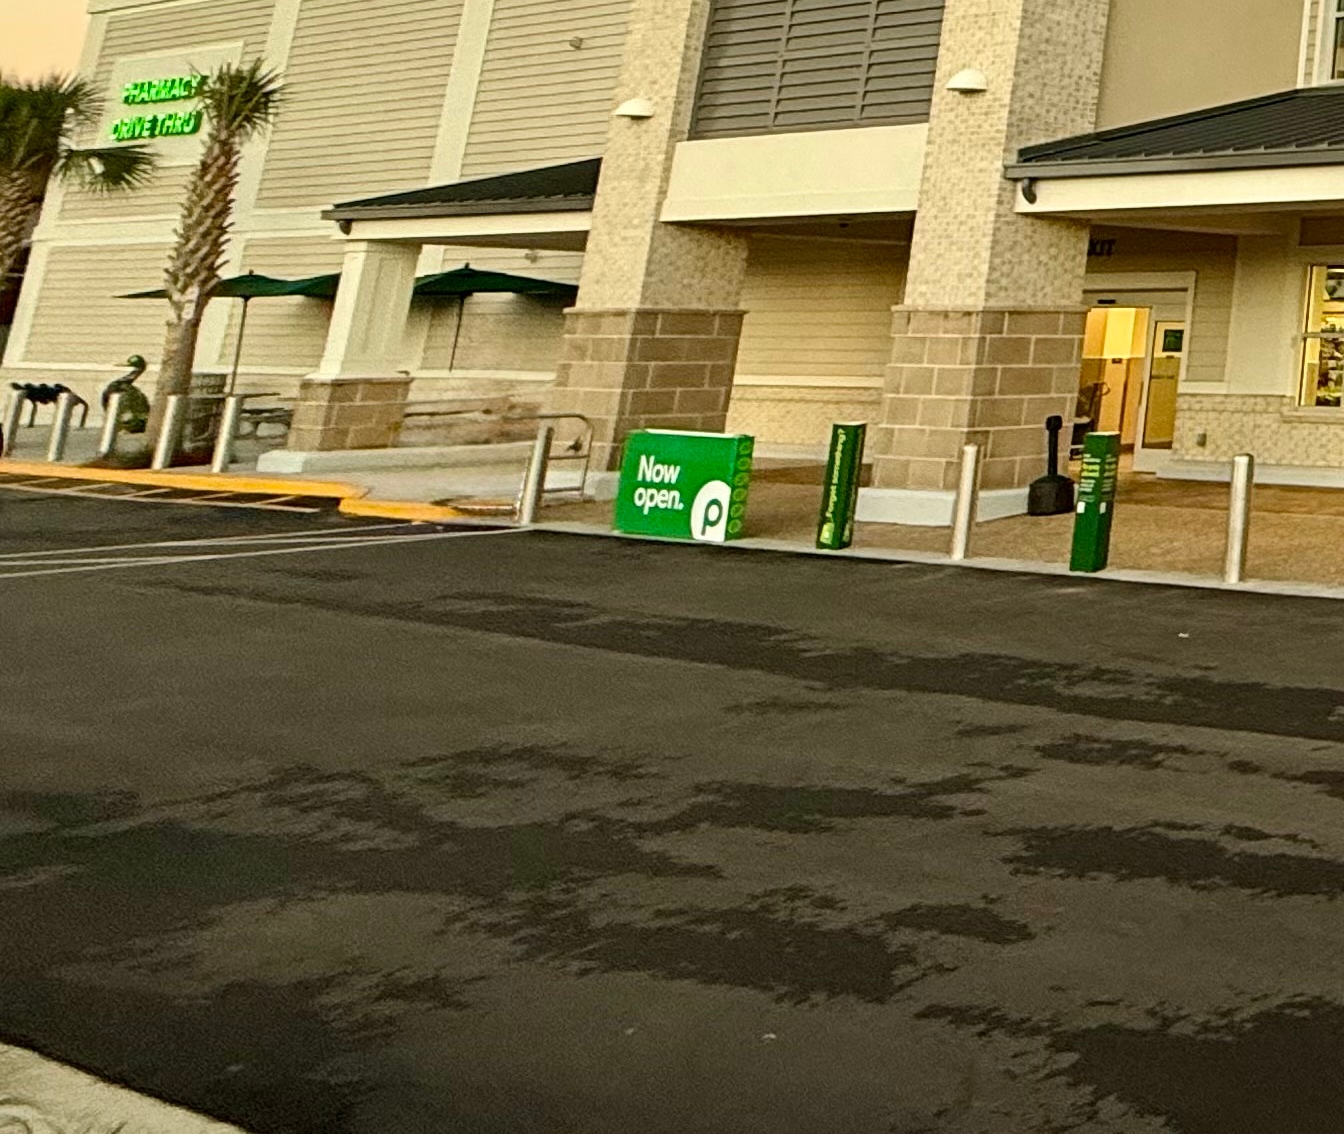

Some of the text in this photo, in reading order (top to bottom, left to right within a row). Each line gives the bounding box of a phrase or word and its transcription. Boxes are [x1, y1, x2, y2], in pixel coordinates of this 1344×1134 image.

[122, 74, 204, 105] PHARMACY
[109, 111, 203, 141] DRIVE THRU
[637, 454, 681, 485] Now
[633, 487, 684, 516] open.
